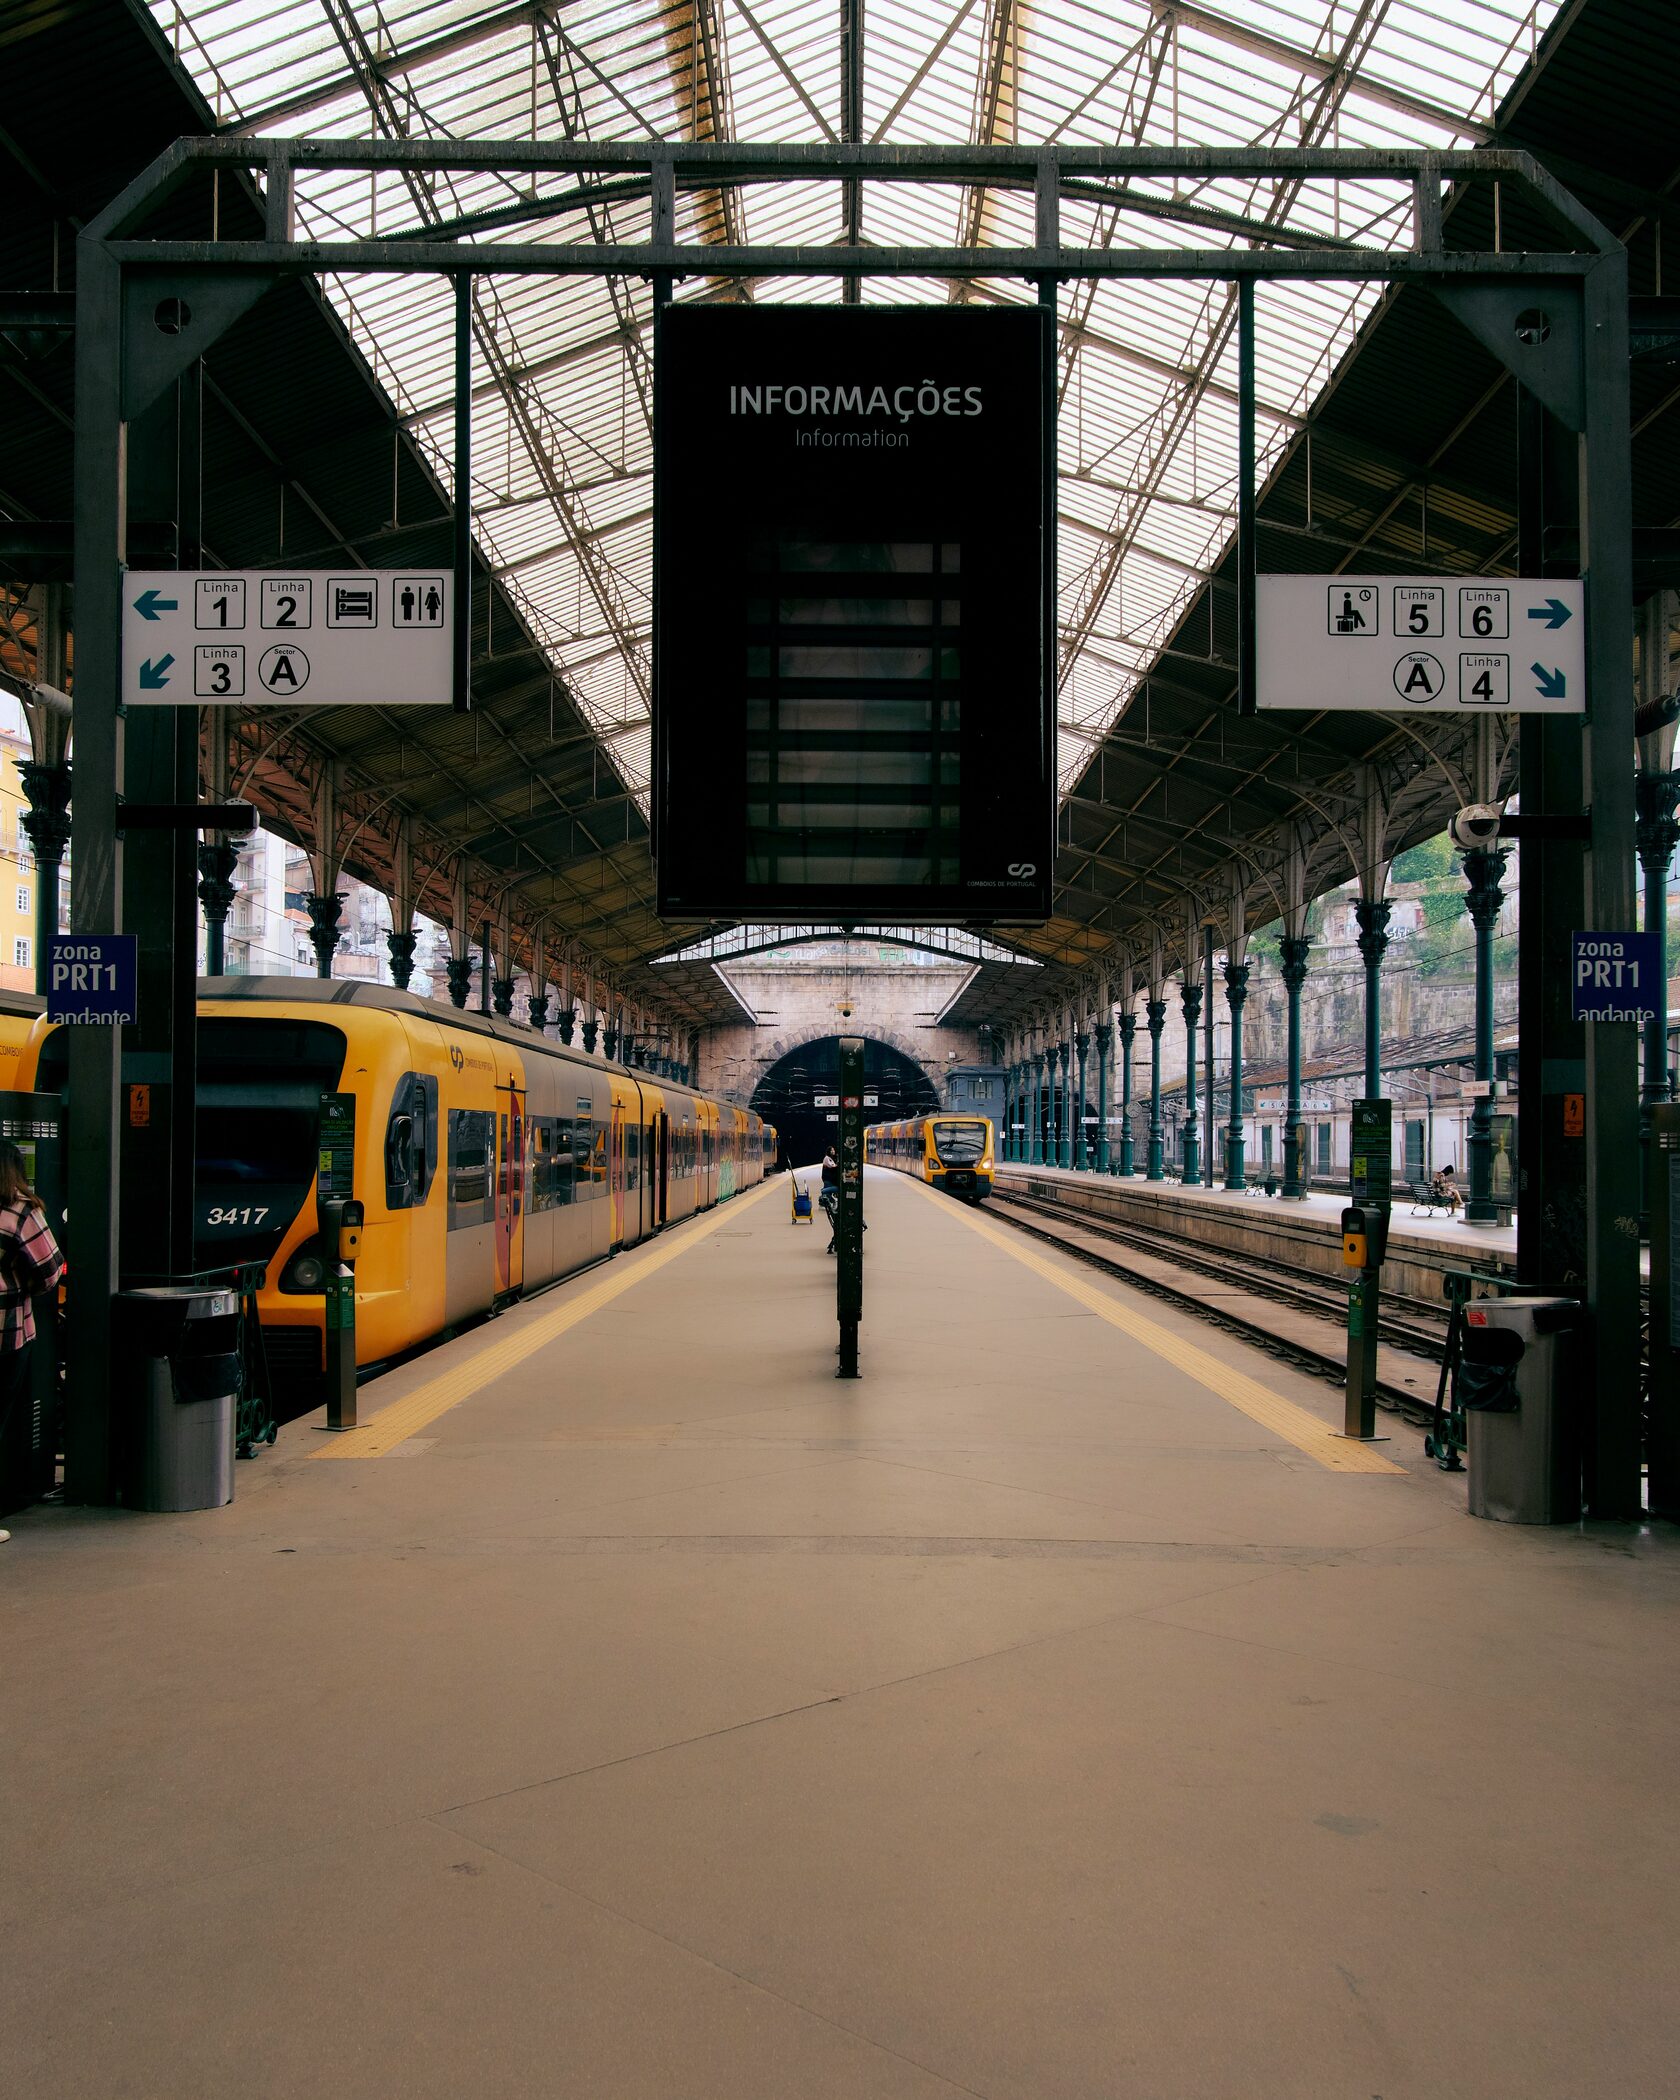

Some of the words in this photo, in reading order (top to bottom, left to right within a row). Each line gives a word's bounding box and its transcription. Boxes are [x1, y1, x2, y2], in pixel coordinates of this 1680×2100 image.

[730, 379, 983, 423] INFORMAÇÕES
[796, 428, 909, 447] Information
[203, 582, 238, 592] Linha
[270, 582, 305, 592] Linha
[1401, 590, 1435, 600] Linha
[1466, 591, 1500, 601] Linha
[213, 597, 227, 627] 1
[276, 596, 297, 626] 2
[1408, 604, 1429, 634] 5
[1472, 605, 1493, 636] 6
[203, 648, 238, 658] Linha
[274, 648, 296, 657] Sector
[1408, 656, 1429, 664] Sector
[268, 655, 298, 686] A
[1466, 657, 1501, 667] Linha
[211, 663, 231, 693] 3
[1404, 663, 1433, 694] A
[1472, 671, 1494, 701] 4
[53, 946, 101, 960] zona
[1577, 942, 1624, 956] zona
[53, 964, 116, 991] PRT1
[1577, 960, 1639, 988] PRT1
[53, 1007, 131, 1024] andante
[1578, 1004, 1655, 1021] andante
[207, 1207, 270, 1225] 3417
